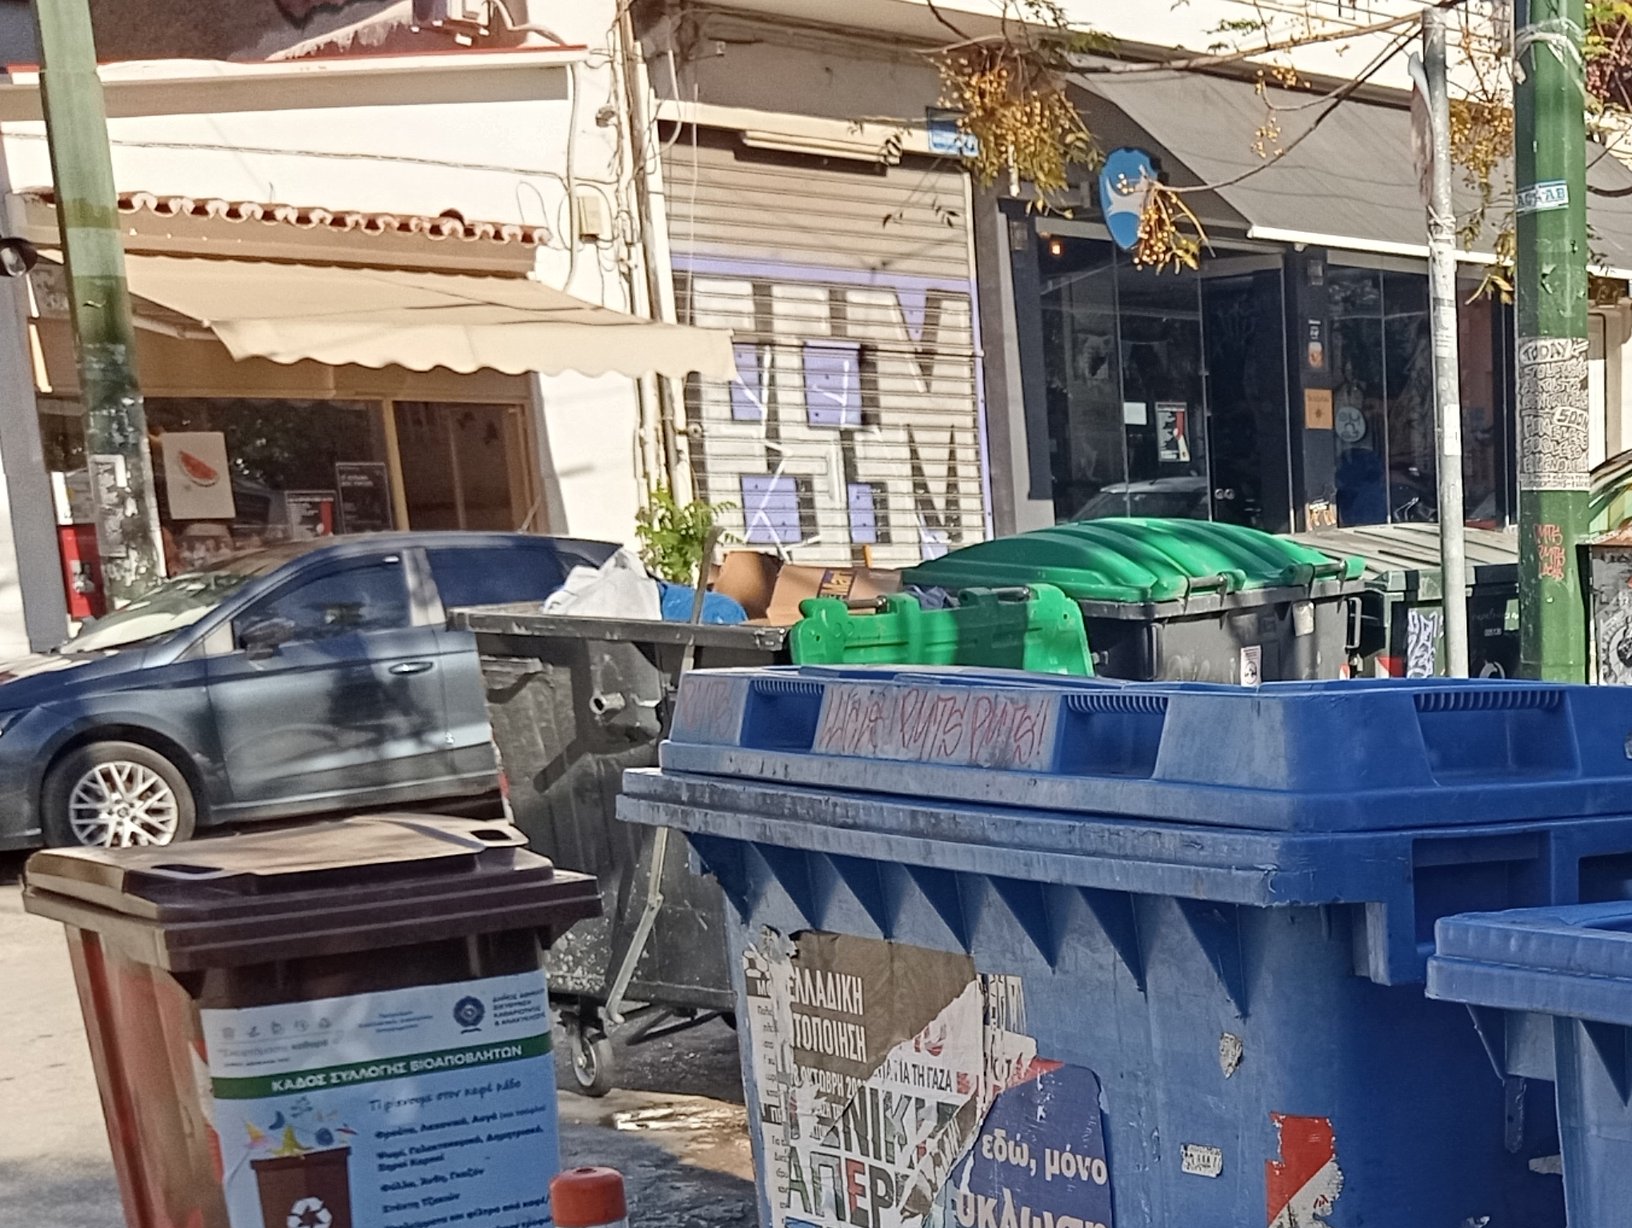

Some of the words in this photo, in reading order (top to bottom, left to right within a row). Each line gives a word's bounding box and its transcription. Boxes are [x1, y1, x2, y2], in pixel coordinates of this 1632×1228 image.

[271, 1072, 327, 1092] ΚΑΔΟΣ
[330, 1060, 407, 1084] ΣΥΛΛΟΓΗΣ
[410, 1045, 523, 1073] ΒΙΟΑΠΟΒΛΗΤΩΝ
[982, 1128, 1036, 1176] εδώ,
[1045, 1144, 1107, 1185] μόνο
